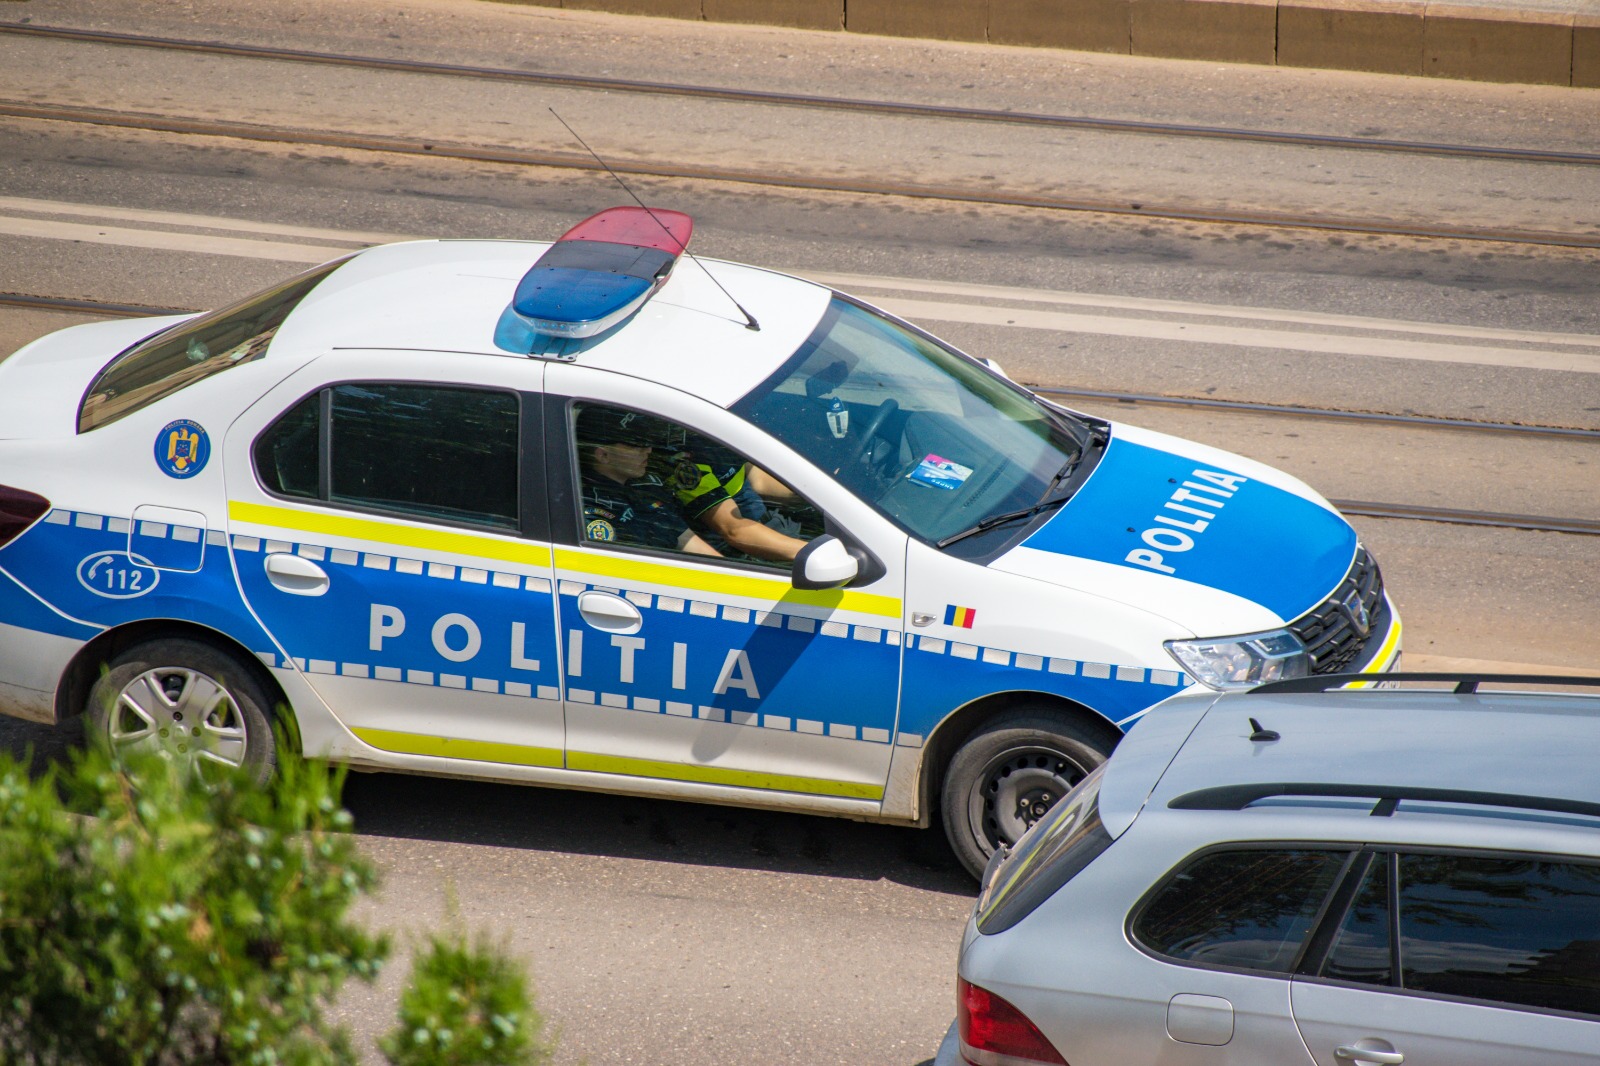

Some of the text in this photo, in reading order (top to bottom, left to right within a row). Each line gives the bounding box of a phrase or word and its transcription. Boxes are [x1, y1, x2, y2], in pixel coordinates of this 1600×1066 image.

[1124, 469, 1248, 574] POLITIA
[105, 568, 142, 590] 112
[369, 603, 760, 699] POLITIA
